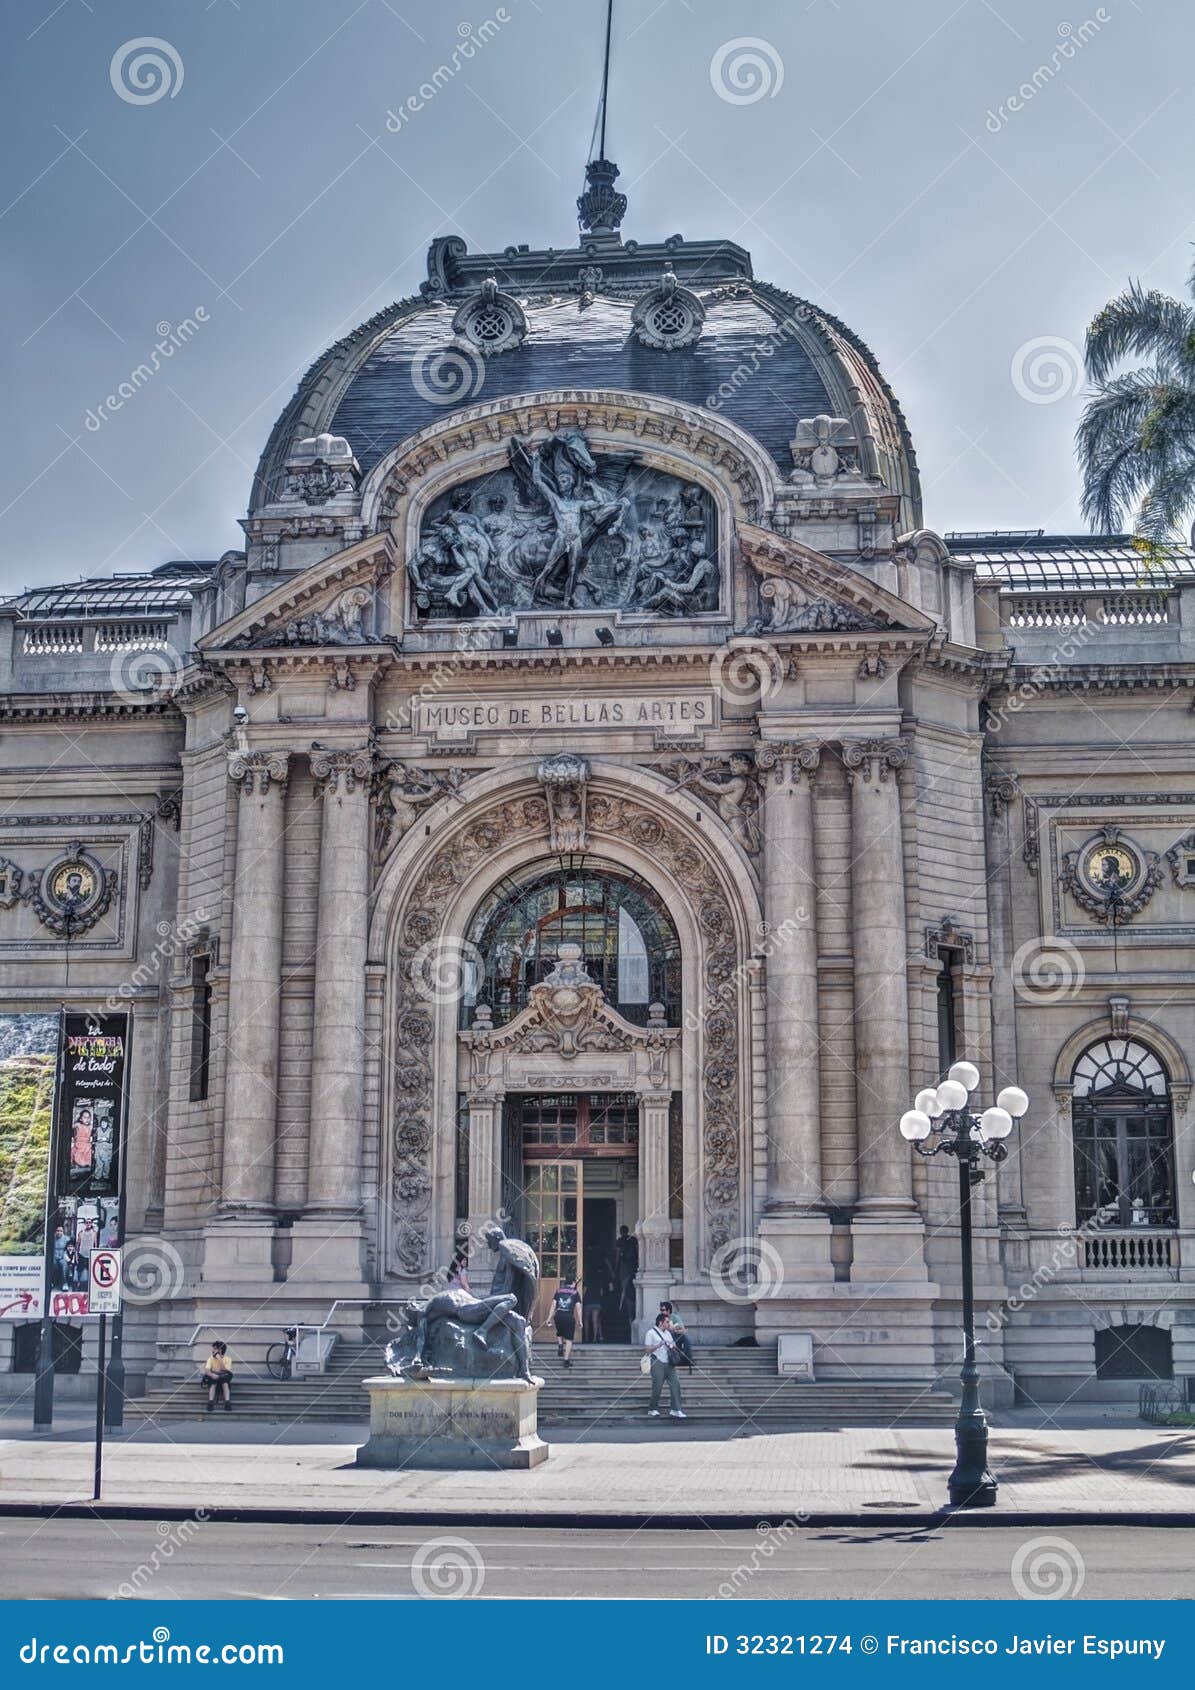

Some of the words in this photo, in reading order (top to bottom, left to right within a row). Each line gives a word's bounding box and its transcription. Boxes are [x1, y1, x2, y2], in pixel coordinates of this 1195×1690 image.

[426, 706, 500, 727] MUSEO
[509, 708, 532, 725] DE
[541, 702, 624, 723] BELLAS
[637, 700, 707, 720] ARTES
[73, 1056, 86, 1071] de
[88, 1056, 117, 1073] todos
